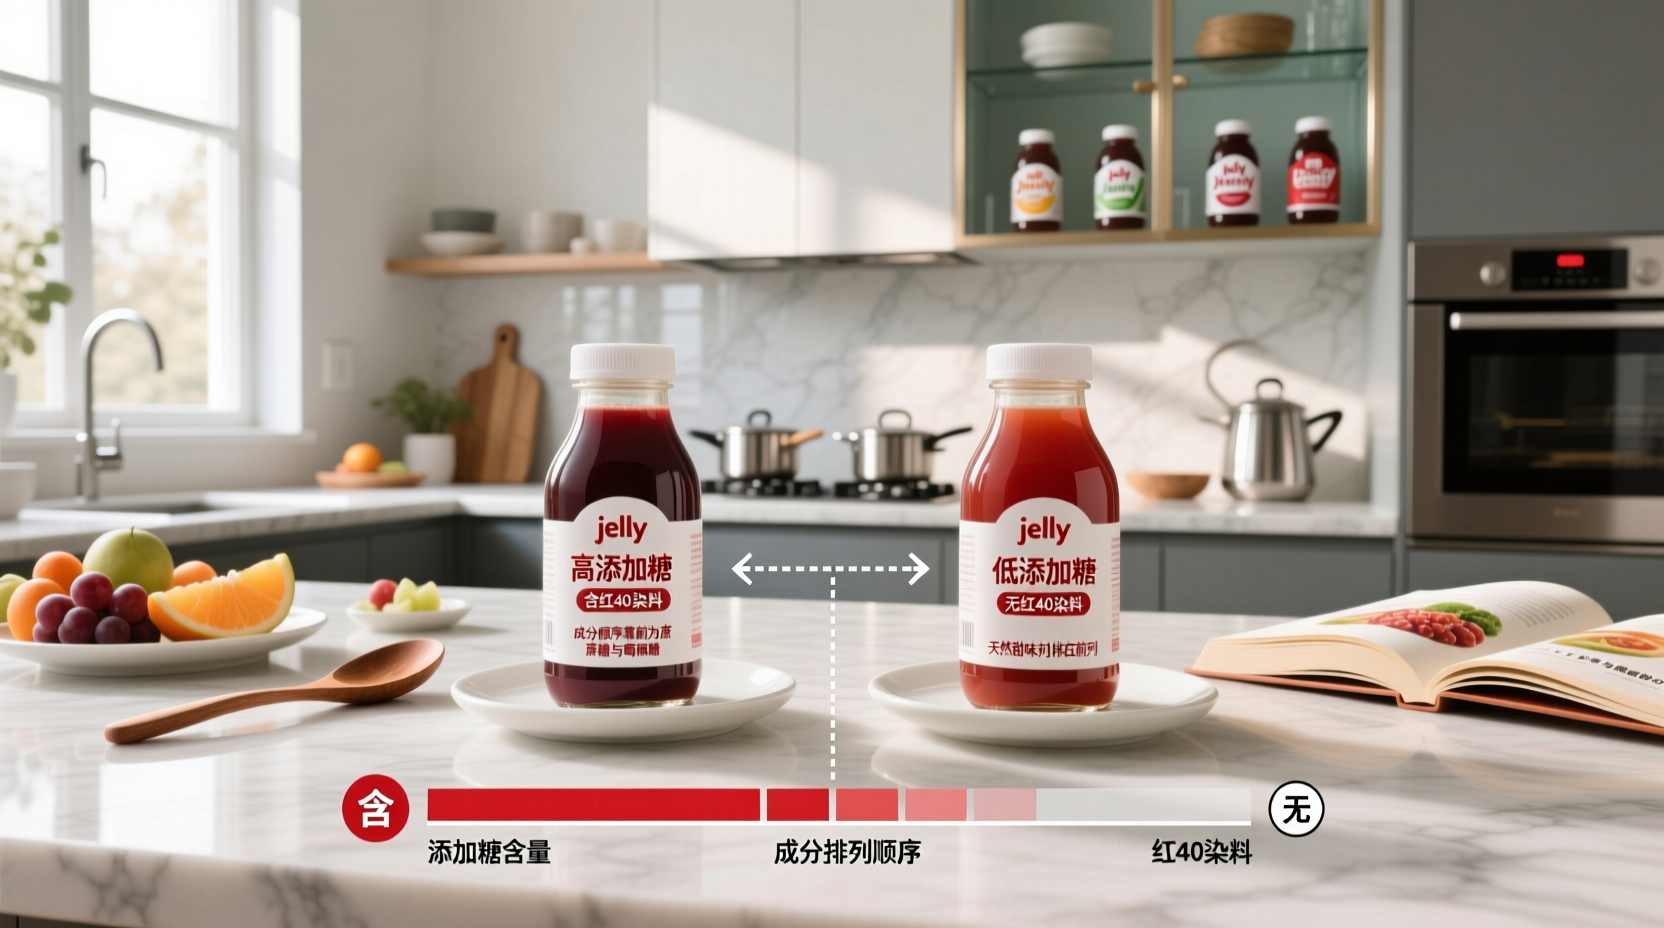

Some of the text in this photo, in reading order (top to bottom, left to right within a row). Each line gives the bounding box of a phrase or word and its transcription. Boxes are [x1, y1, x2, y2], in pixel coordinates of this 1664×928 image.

[594, 514, 648, 545] jelly
[1016, 515, 1072, 546] jelly
[571, 552, 673, 583] 高添加糖
[992, 556, 1097, 586] 低添加糖
[1005, 595, 1084, 613] 无红40染料
